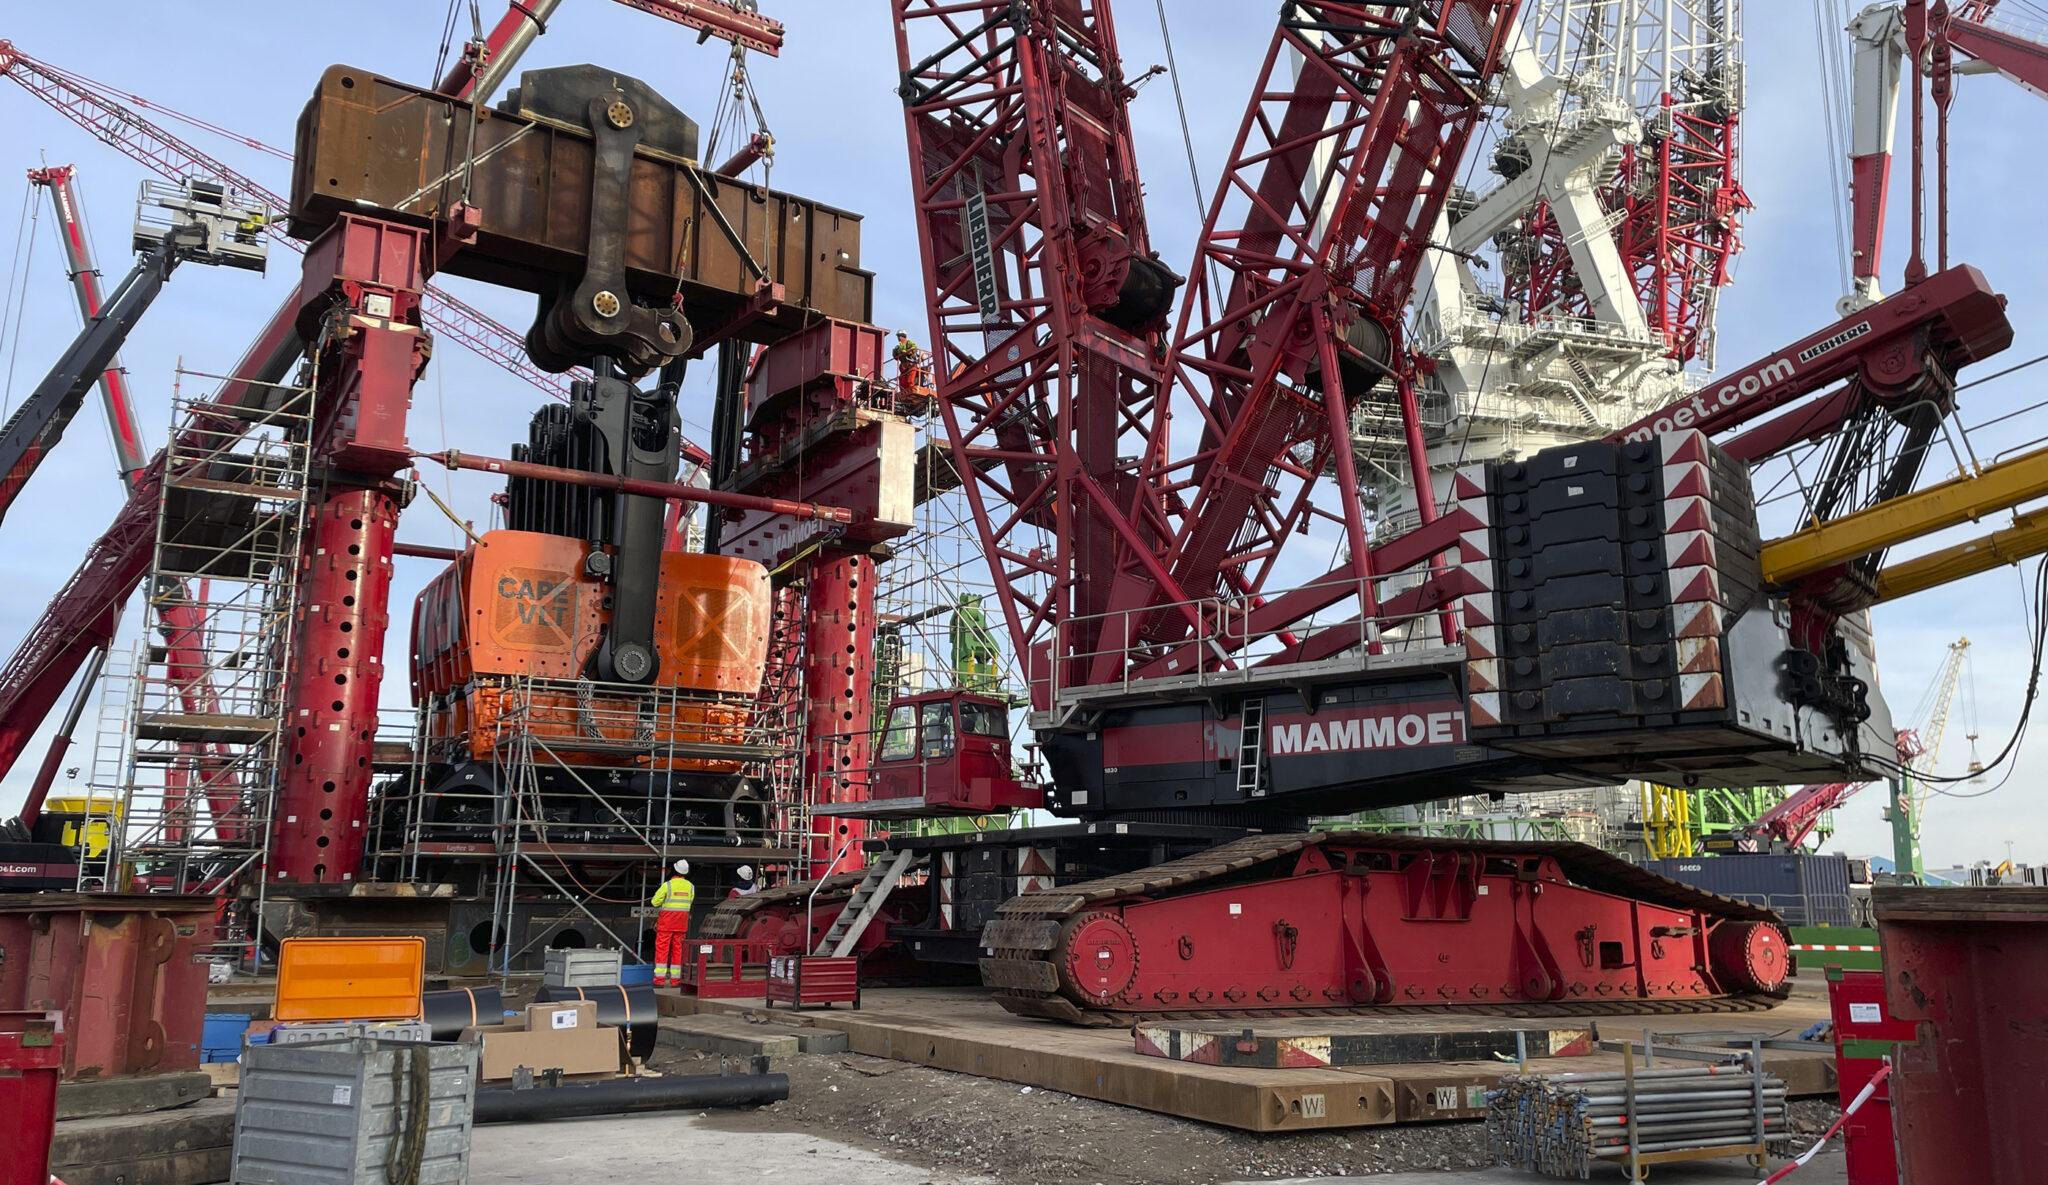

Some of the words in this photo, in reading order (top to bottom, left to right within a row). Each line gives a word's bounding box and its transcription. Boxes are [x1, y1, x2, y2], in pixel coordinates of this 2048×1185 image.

[967, 194, 997, 320] LIEBHERR
[1801, 323, 1870, 363] LIEBHERR
[498, 577, 569, 604] CAPE
[517, 602, 568, 627] VLT
[1304, 1097, 1319, 1115] W
[1438, 1089, 1452, 1107] W
